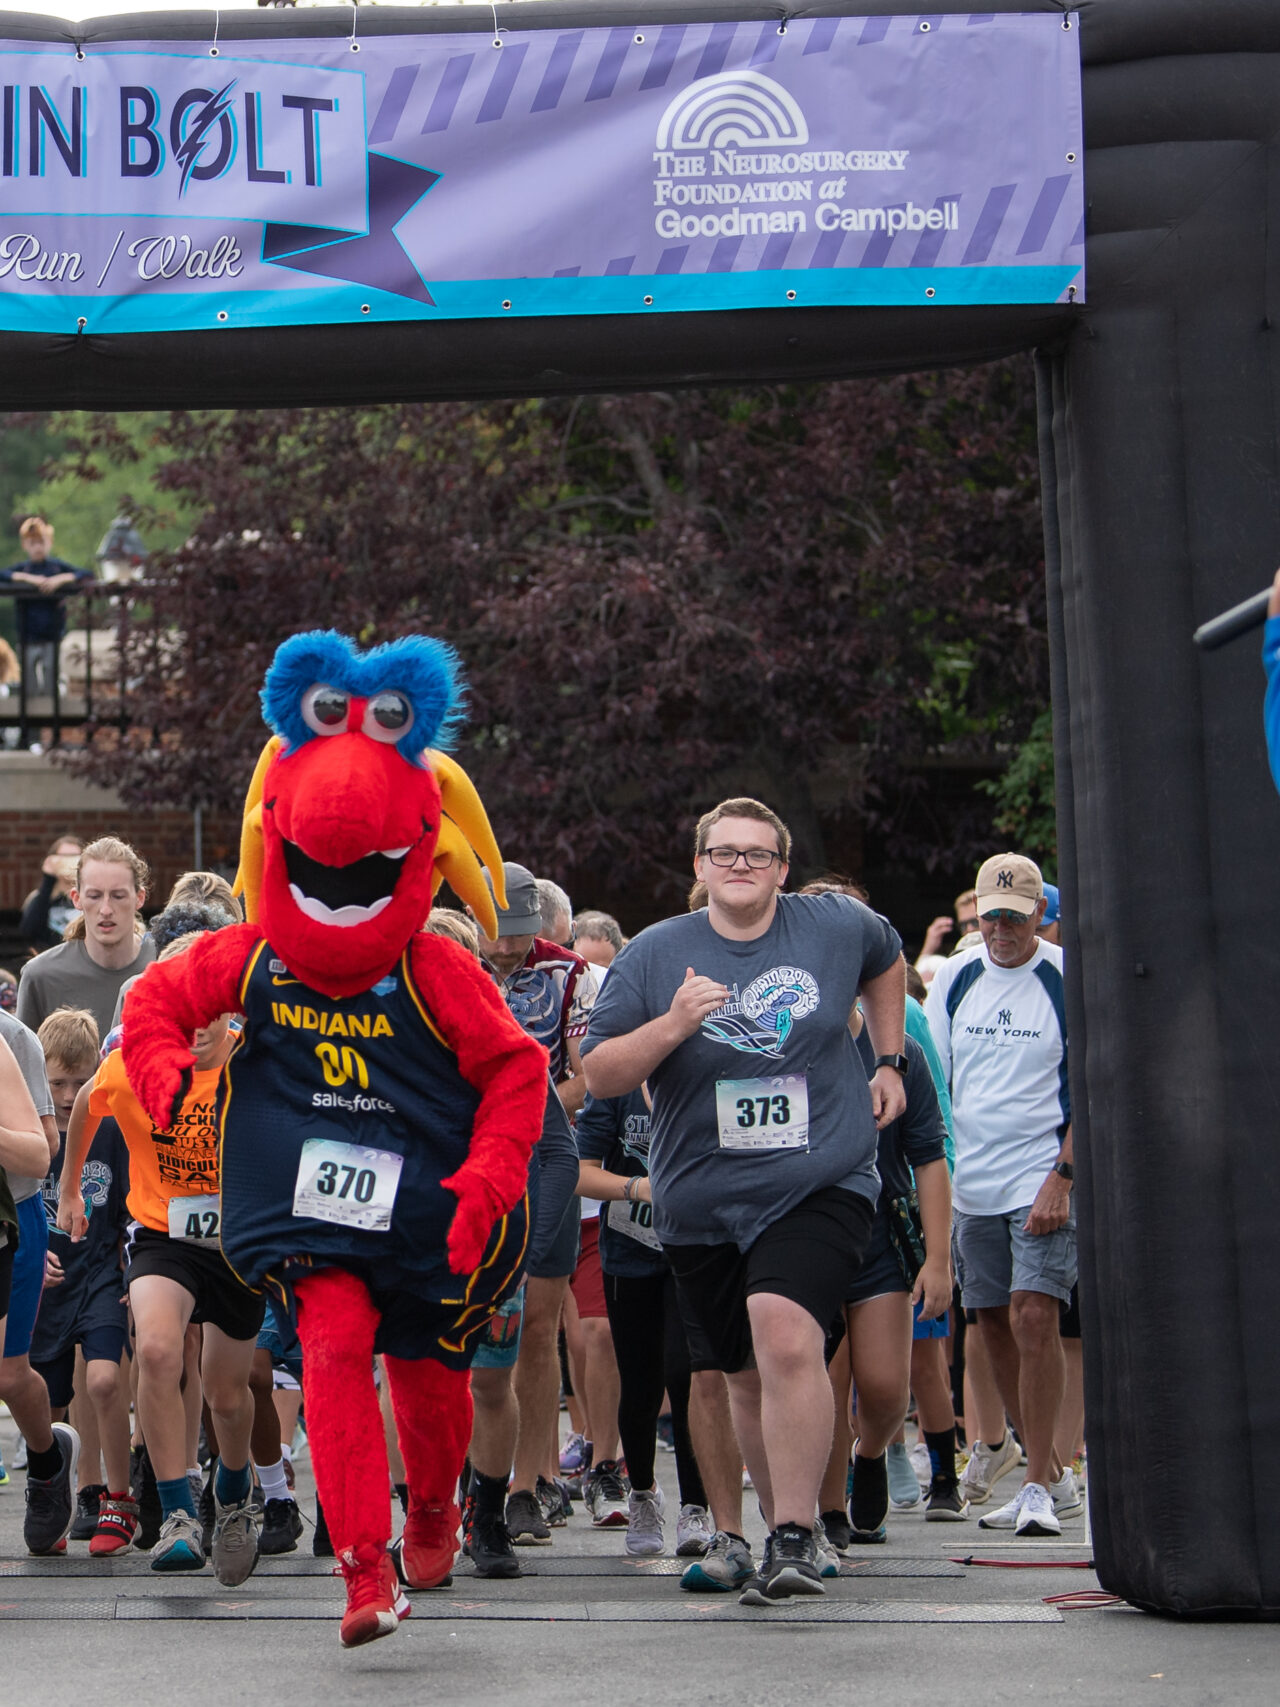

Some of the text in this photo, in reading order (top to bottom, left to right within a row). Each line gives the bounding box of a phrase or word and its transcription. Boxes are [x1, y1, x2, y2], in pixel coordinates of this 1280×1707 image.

[120, 83, 337, 190] BOLT
[818, 176, 847, 199] at
[655, 201, 959, 238] Goodman Campbell
[272, 1002, 395, 1037] INDIANA
[965, 1026, 1041, 1038] NEW YORK
[736, 1095, 790, 1128] 373
[157, 1152, 219, 1172] RIDICUL
[317, 1161, 376, 1203] 370
